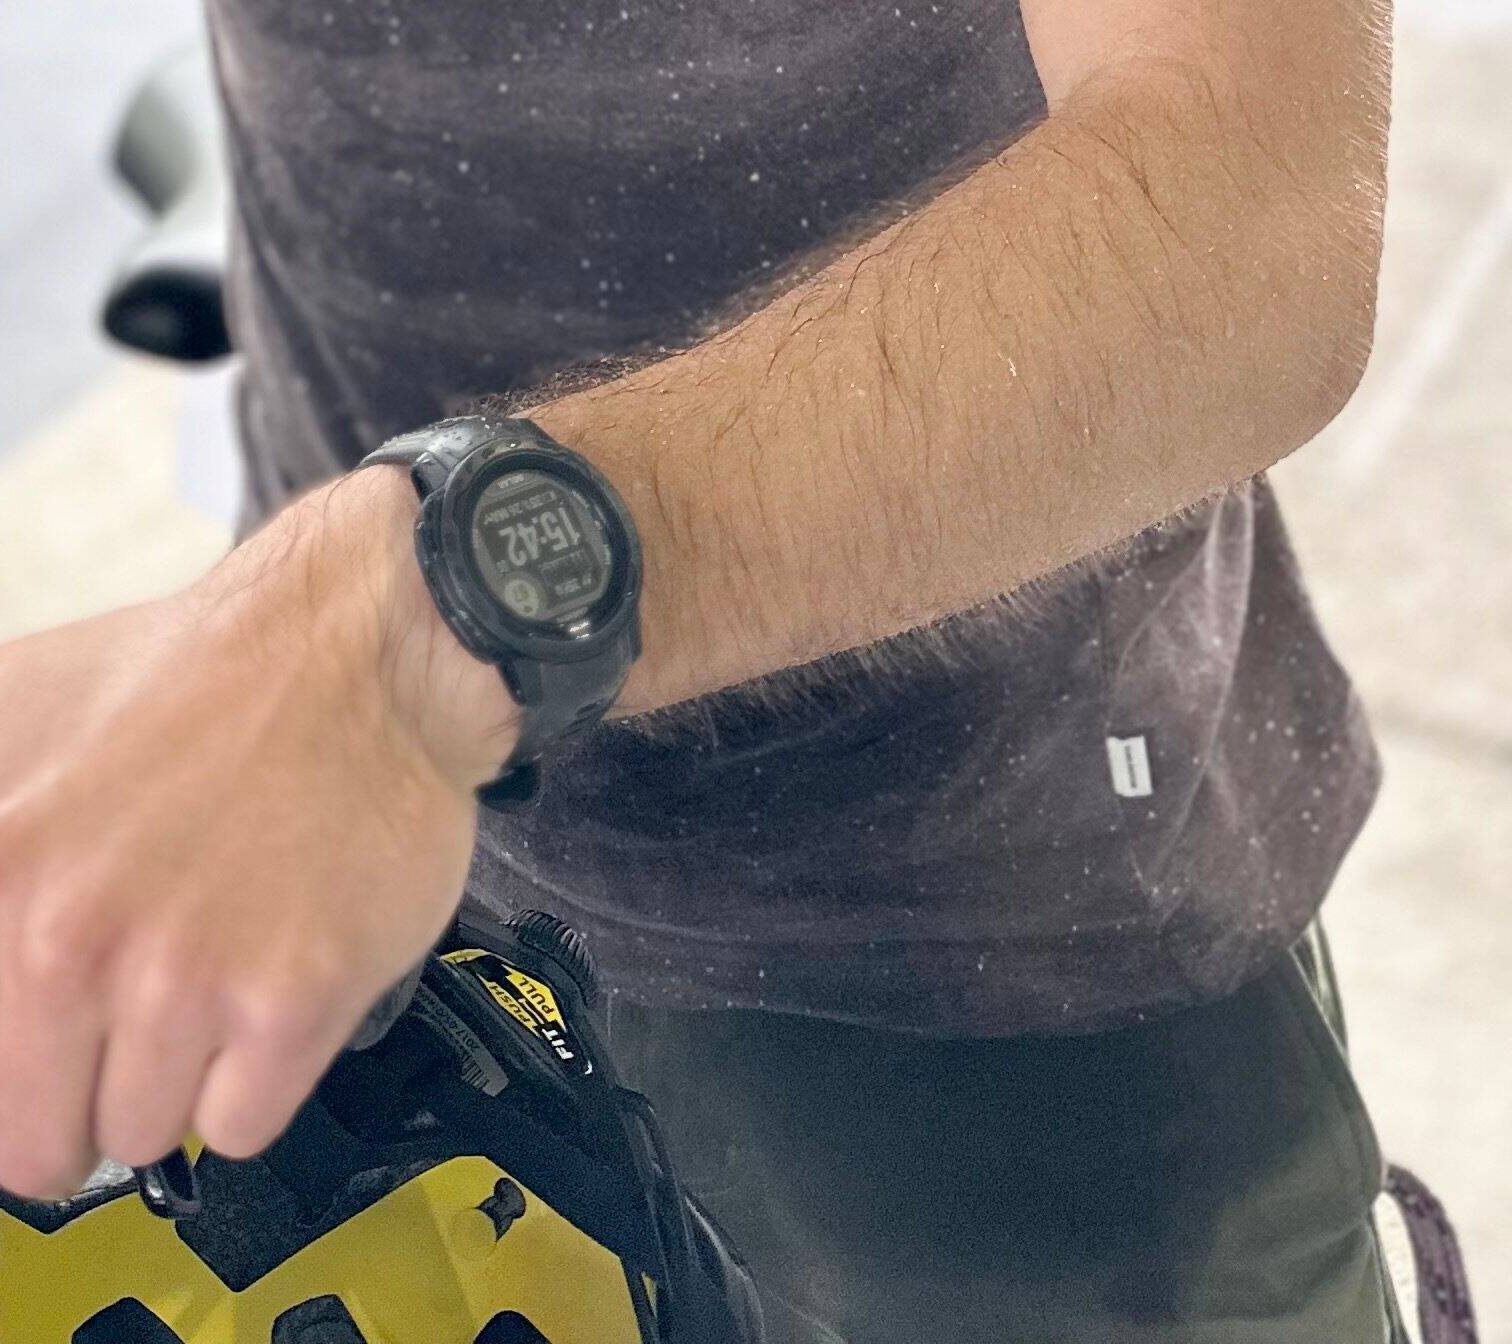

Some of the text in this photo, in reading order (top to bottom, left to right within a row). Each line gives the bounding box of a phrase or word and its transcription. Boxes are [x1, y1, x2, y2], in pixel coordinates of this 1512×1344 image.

[498, 507, 580, 566] 15:42
[489, 984, 529, 1022] PUSH
[519, 977, 554, 1014] PULL
[542, 1027, 574, 1060] FIT
